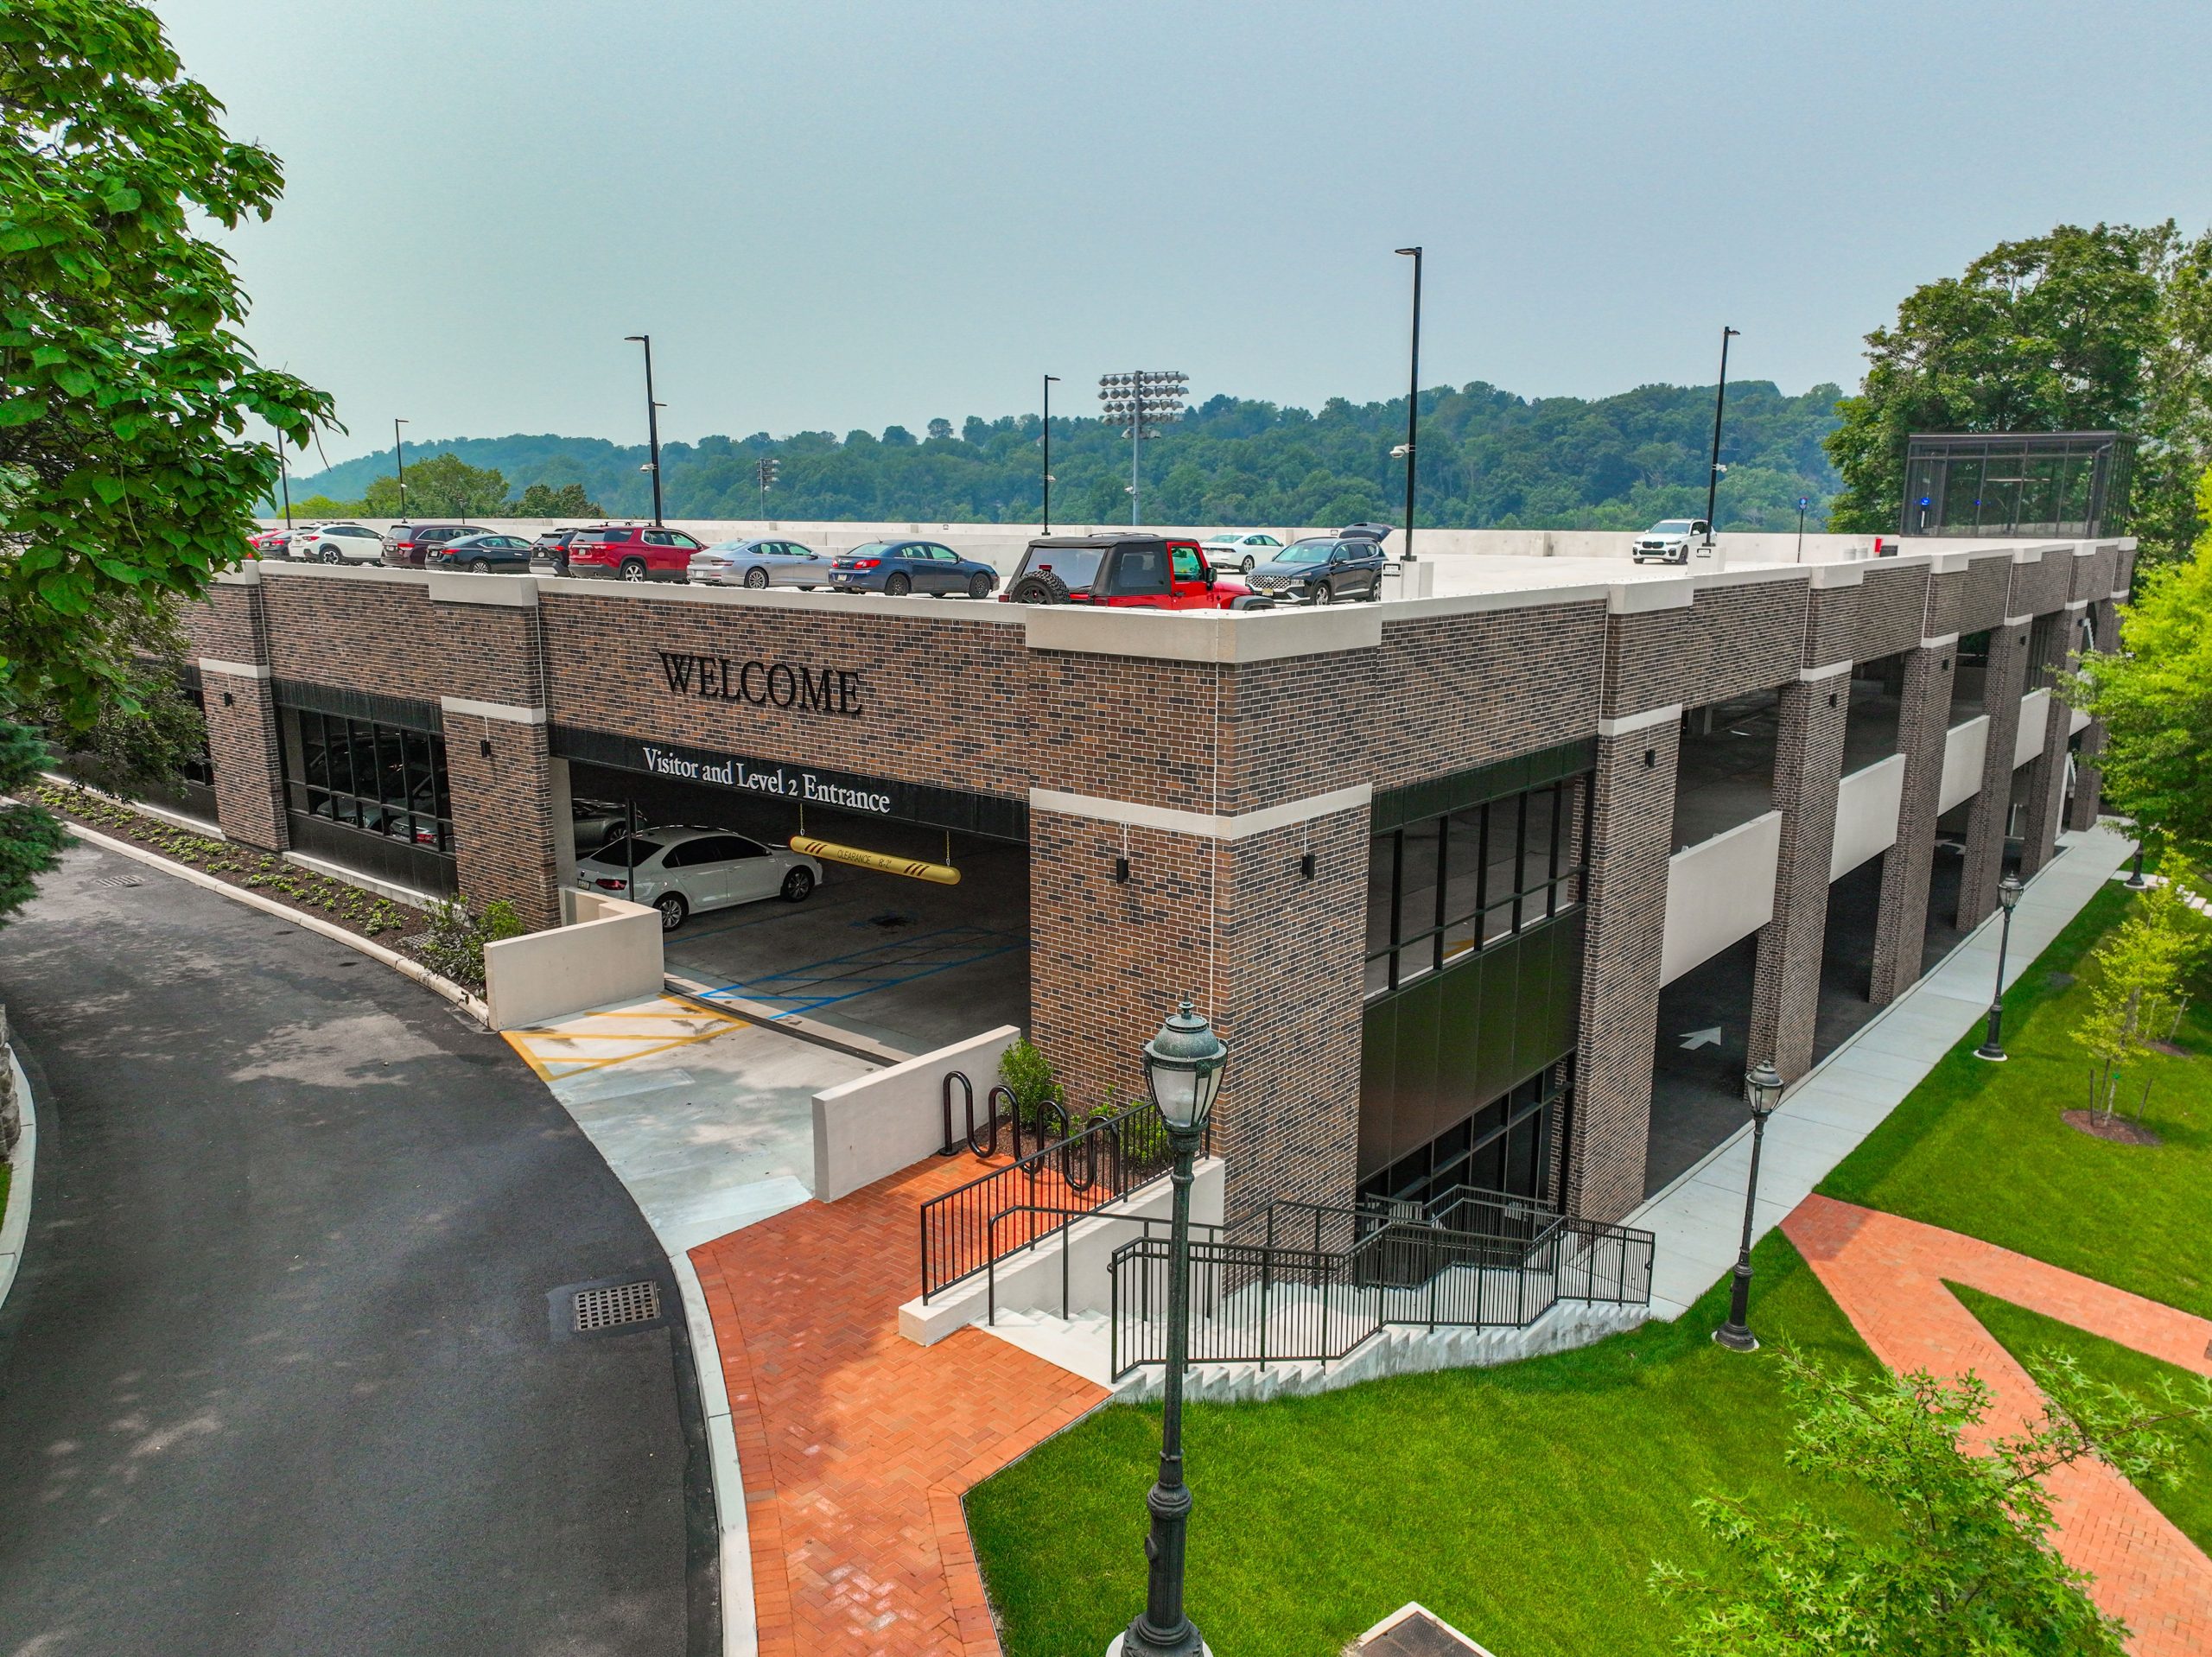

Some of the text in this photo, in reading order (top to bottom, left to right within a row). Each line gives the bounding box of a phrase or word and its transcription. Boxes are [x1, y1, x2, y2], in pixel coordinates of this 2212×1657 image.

[658, 652, 862, 714] WELCOME
[643, 747, 890, 814] Visitor and Level 2 Entrance
[837, 849, 871, 865] CLEARANCE
